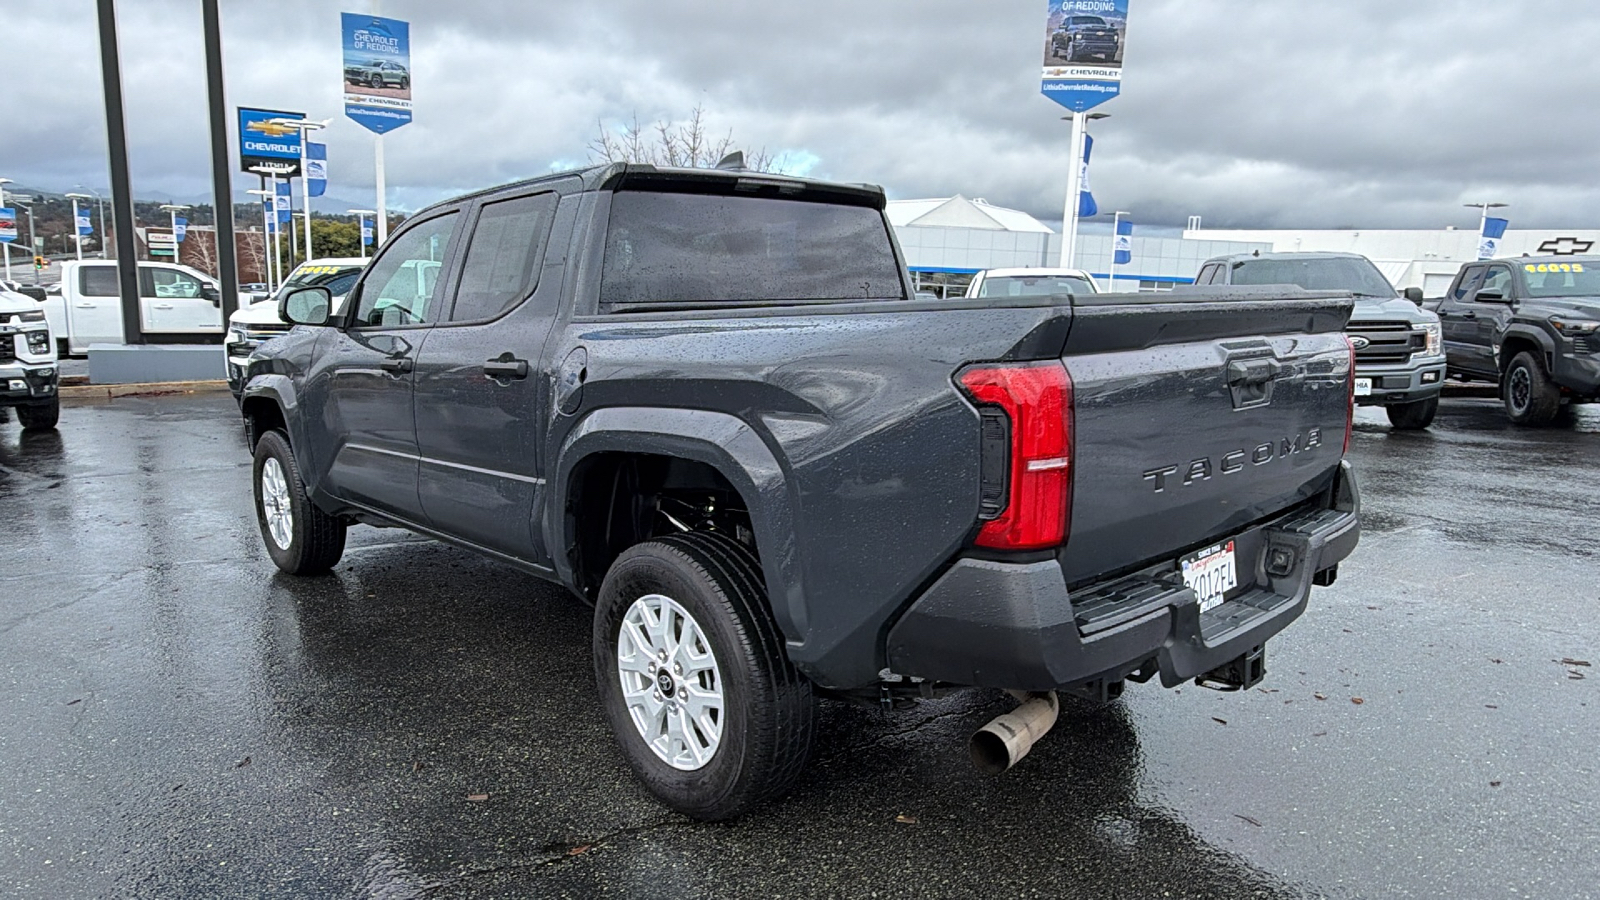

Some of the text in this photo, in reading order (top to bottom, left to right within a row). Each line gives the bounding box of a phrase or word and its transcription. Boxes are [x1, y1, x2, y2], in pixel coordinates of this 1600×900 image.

[1062, 1, 1115, 12] OF REDDING
[353, 33, 399, 46] CHEVROLET
[354, 41, 399, 54] OF REDDING
[1070, 69, 1119, 77] CHEVROLET
[1043, 83, 1118, 93] LithiaChevroletRedding.com
[368, 97, 409, 107] CHEVROLET
[244, 141, 302, 154] CHEVROLET
[1142, 426, 1323, 493] TACOMA
